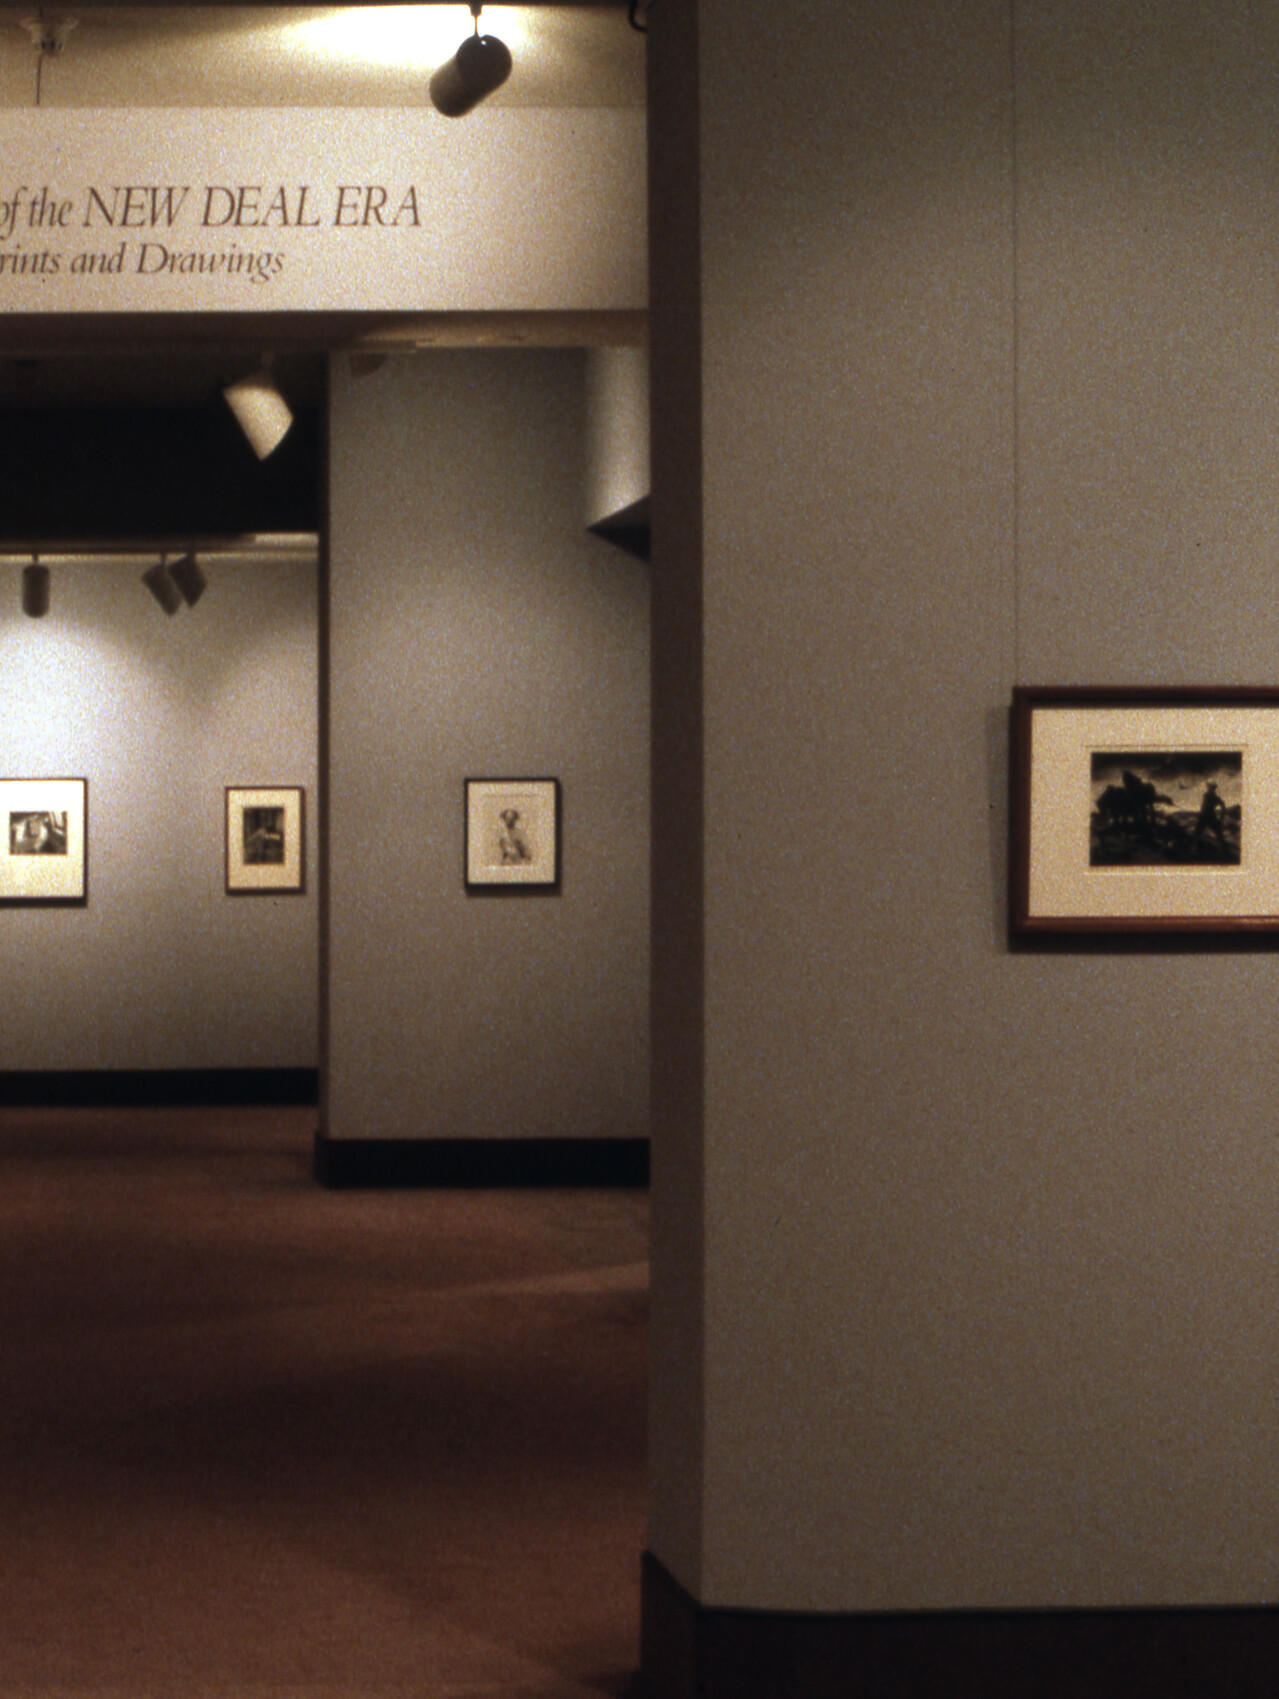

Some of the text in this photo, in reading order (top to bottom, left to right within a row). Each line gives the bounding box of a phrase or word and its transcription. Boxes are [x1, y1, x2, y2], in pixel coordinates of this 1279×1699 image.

[28, 187, 73, 228] the
[82, 185, 192, 228] NEW
[201, 185, 322, 227] DEAL
[333, 185, 422, 227] ERA
[70, 241, 127, 274] and
[136, 242, 286, 282] Drawings
